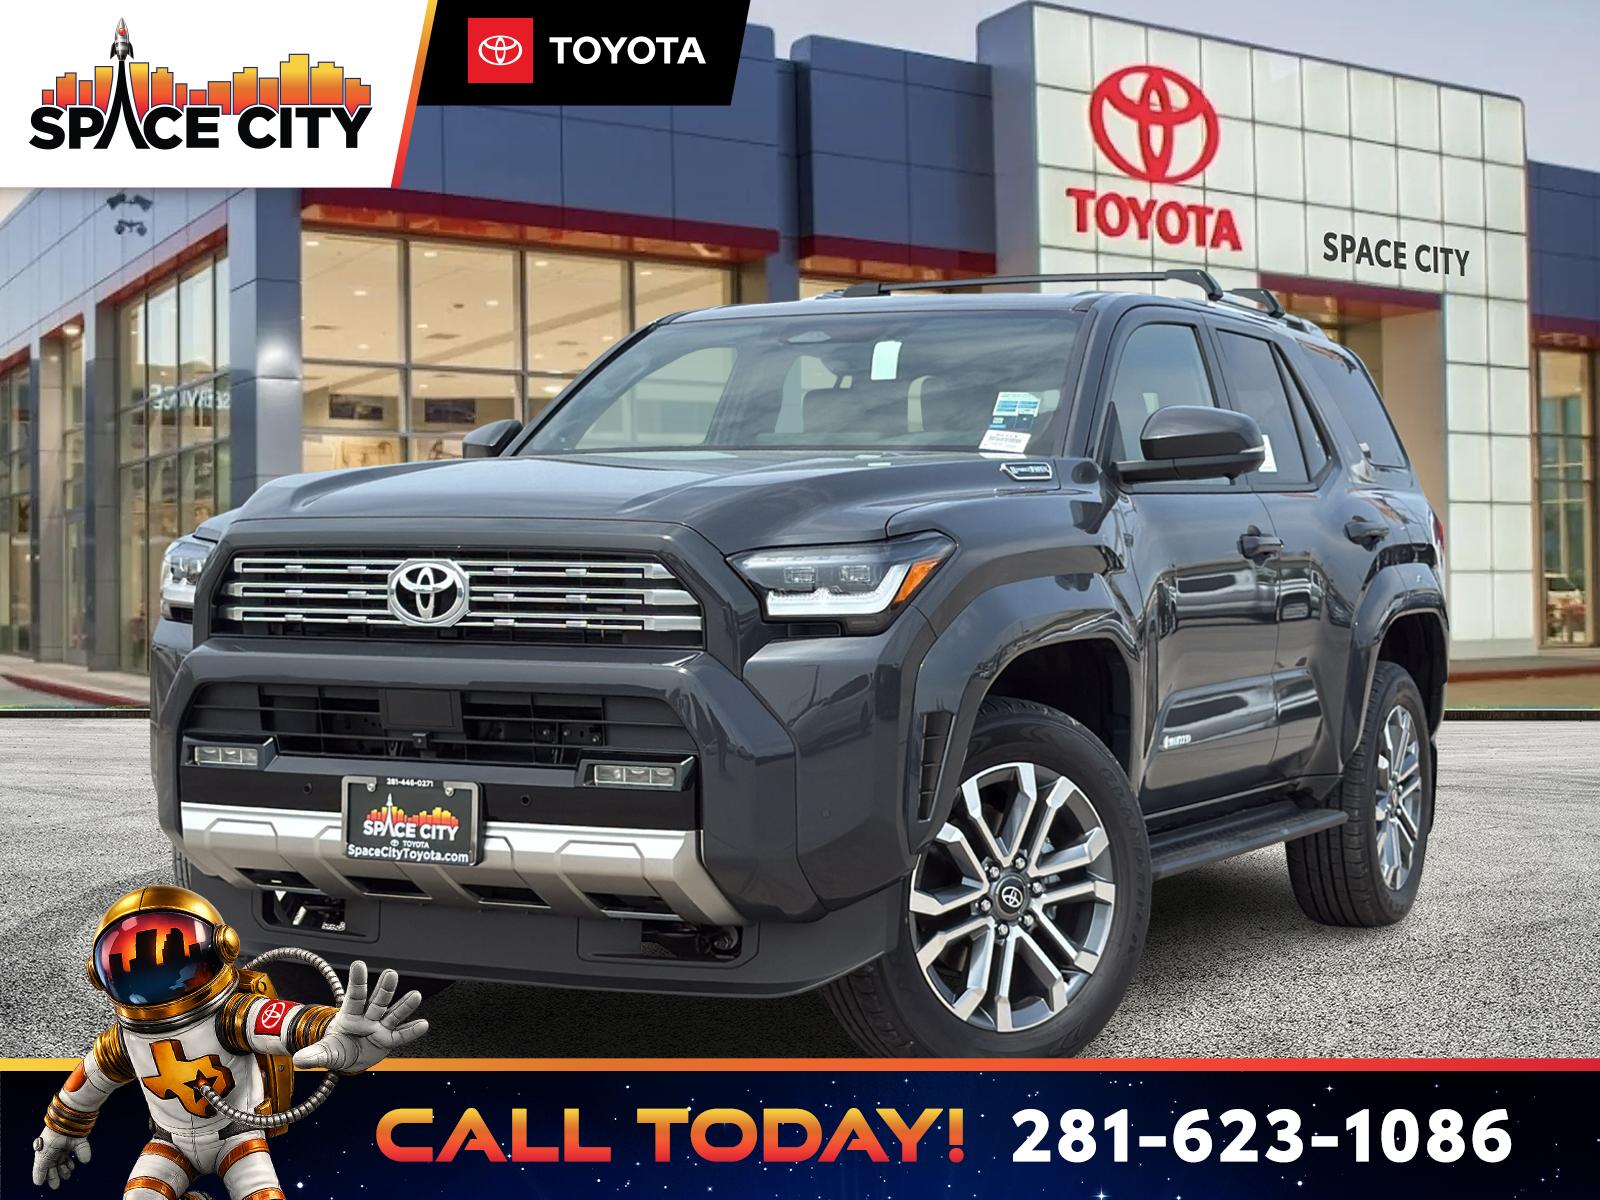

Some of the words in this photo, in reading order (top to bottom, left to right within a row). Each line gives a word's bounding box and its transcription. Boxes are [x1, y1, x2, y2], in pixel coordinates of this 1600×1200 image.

[1066, 188, 1242, 251] TOYOTA
[1323, 232, 1407, 270] SPACE
[1414, 244, 1470, 277] CITY
[362, 819, 417, 839] SPACE
[419, 824, 459, 841] CITY
[347, 844, 469, 862] SpaceCityToyota.com
[402, 840, 430, 849] TOYOTA
